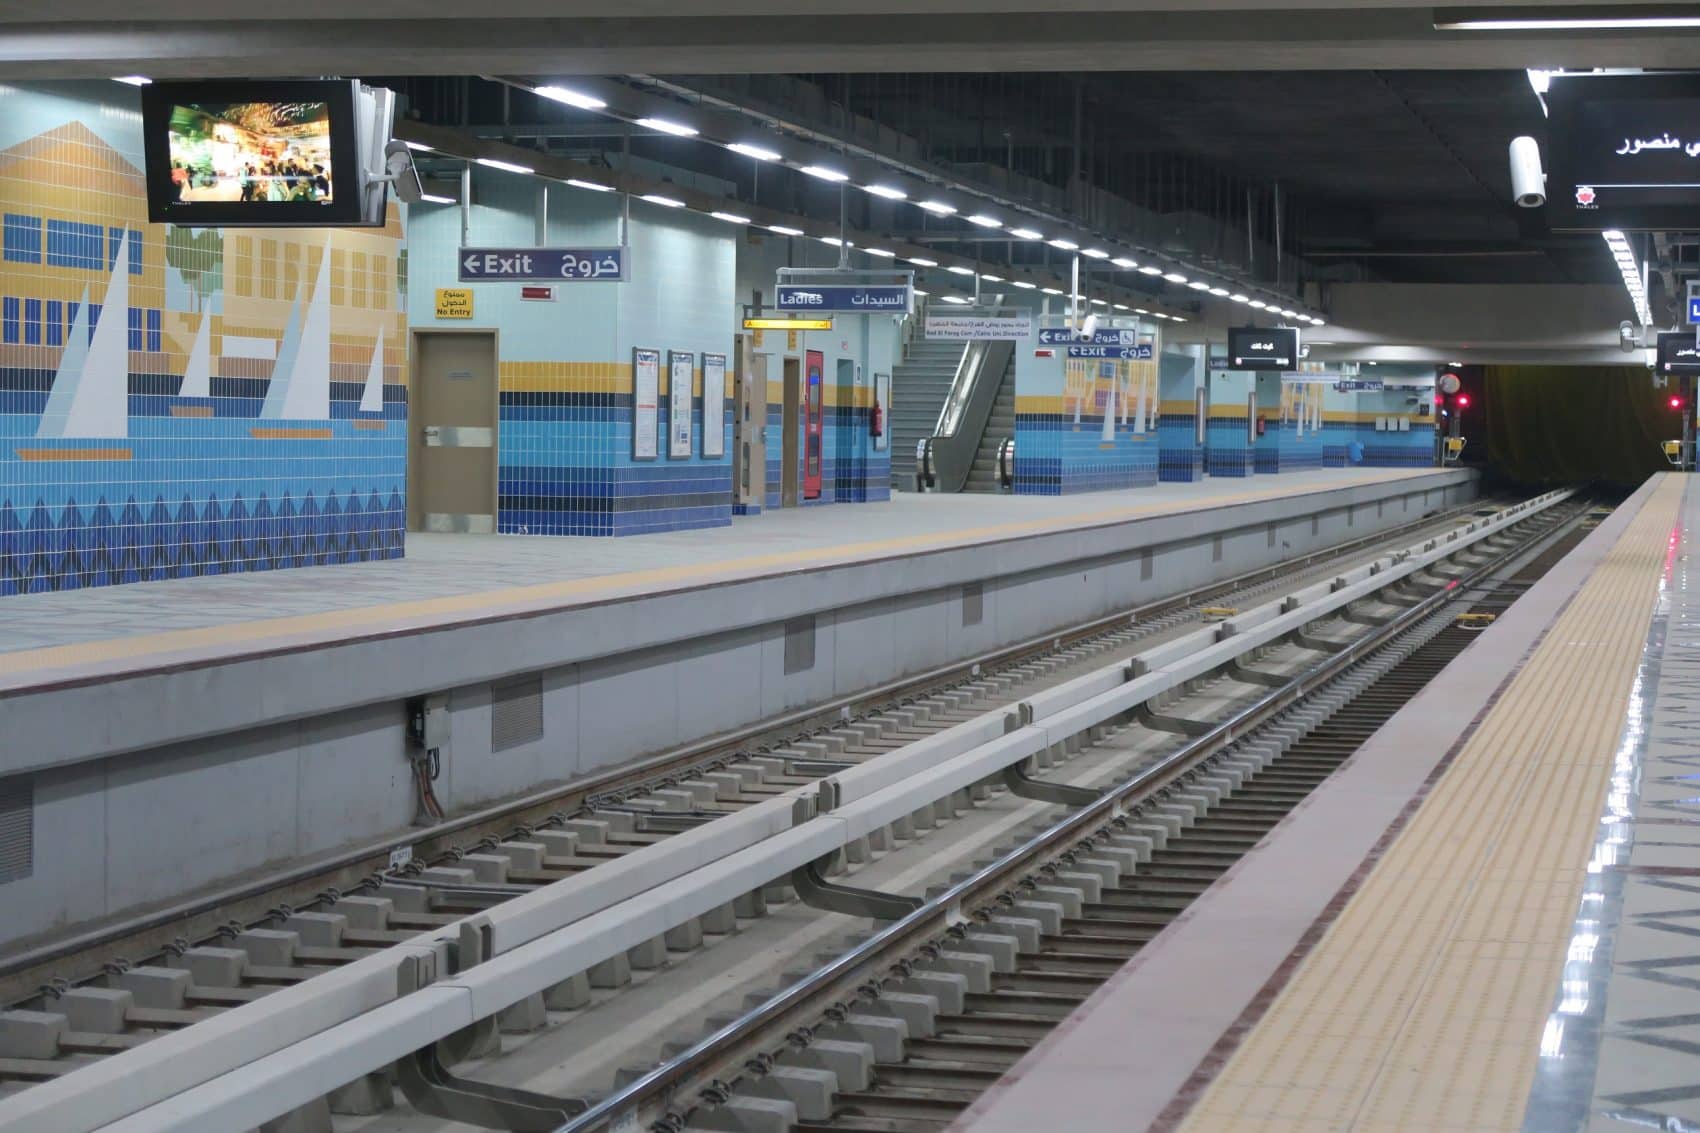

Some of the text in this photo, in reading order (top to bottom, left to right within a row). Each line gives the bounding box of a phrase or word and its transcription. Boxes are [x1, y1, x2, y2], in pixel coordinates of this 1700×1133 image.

[1616, 133, 1680, 154] منصور
[484, 253, 533, 274] Exit
[561, 254, 619, 277] خروج
[780, 292, 823, 305] Ladies
[851, 293, 904, 307] السيدات
[449, 309, 470, 317] Entry
[1054, 333, 1072, 341] Exi
[1095, 333, 1120, 343] خروج
[1120, 346, 1151, 359] خروج
